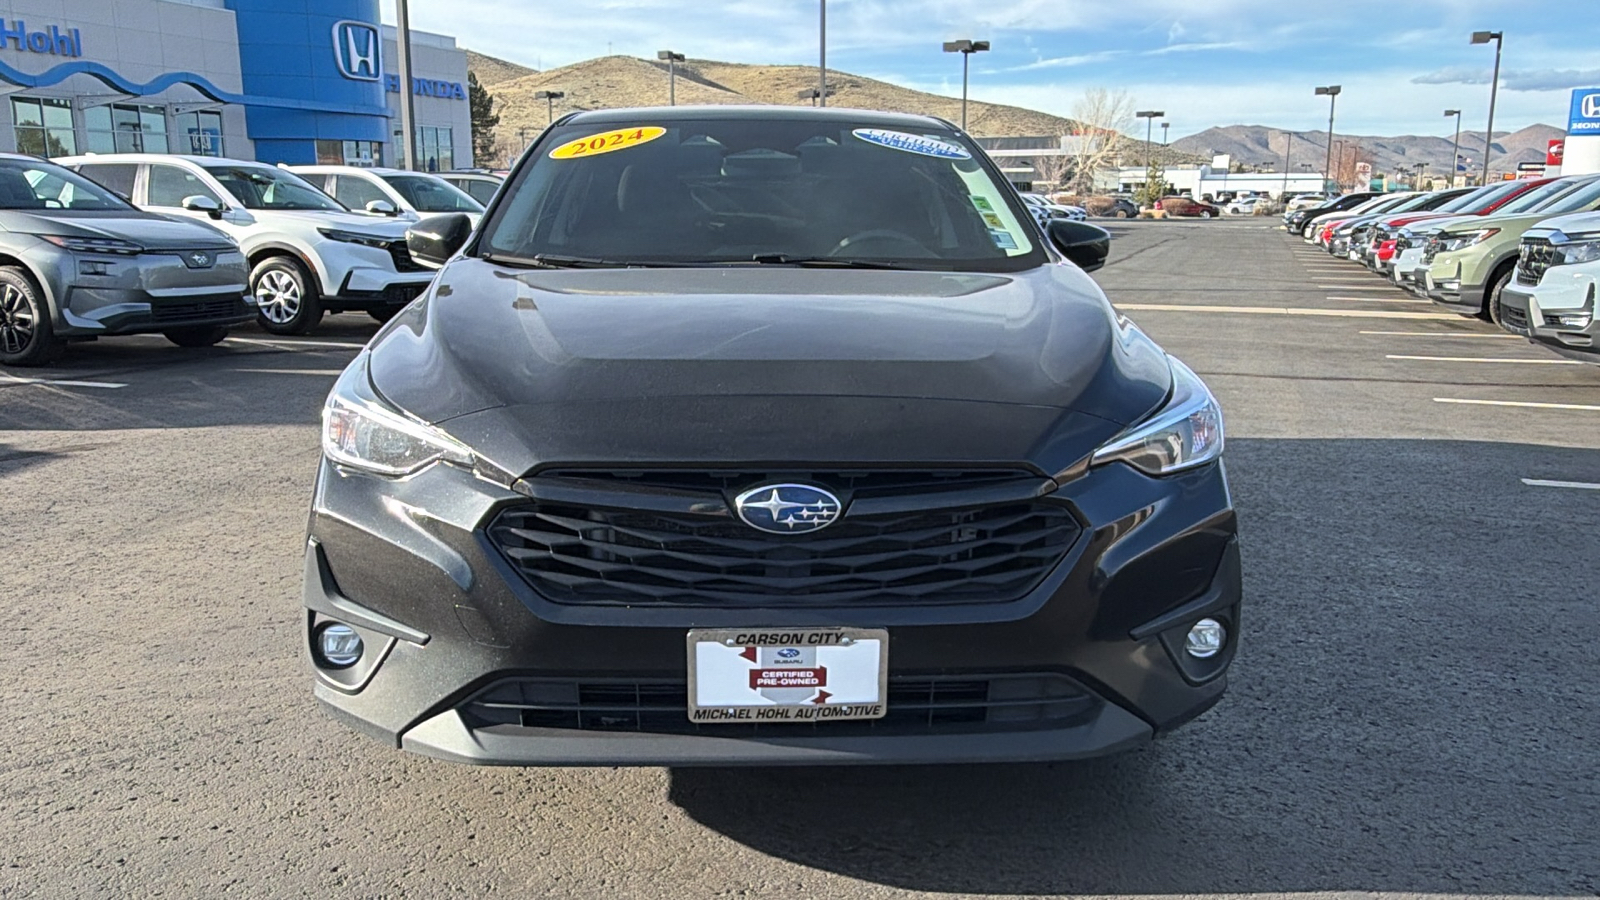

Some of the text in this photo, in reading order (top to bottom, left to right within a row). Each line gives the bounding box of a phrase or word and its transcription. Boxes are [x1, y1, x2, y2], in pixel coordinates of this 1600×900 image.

[0, 18, 82, 57] Hohl
[572, 129, 644, 155] 2024
[735, 632, 845, 645] CARSON CITY
[757, 678, 819, 686] PRE-OWNED
[694, 704, 882, 720] MICHAEL HOHL AUTOMOTIVE
